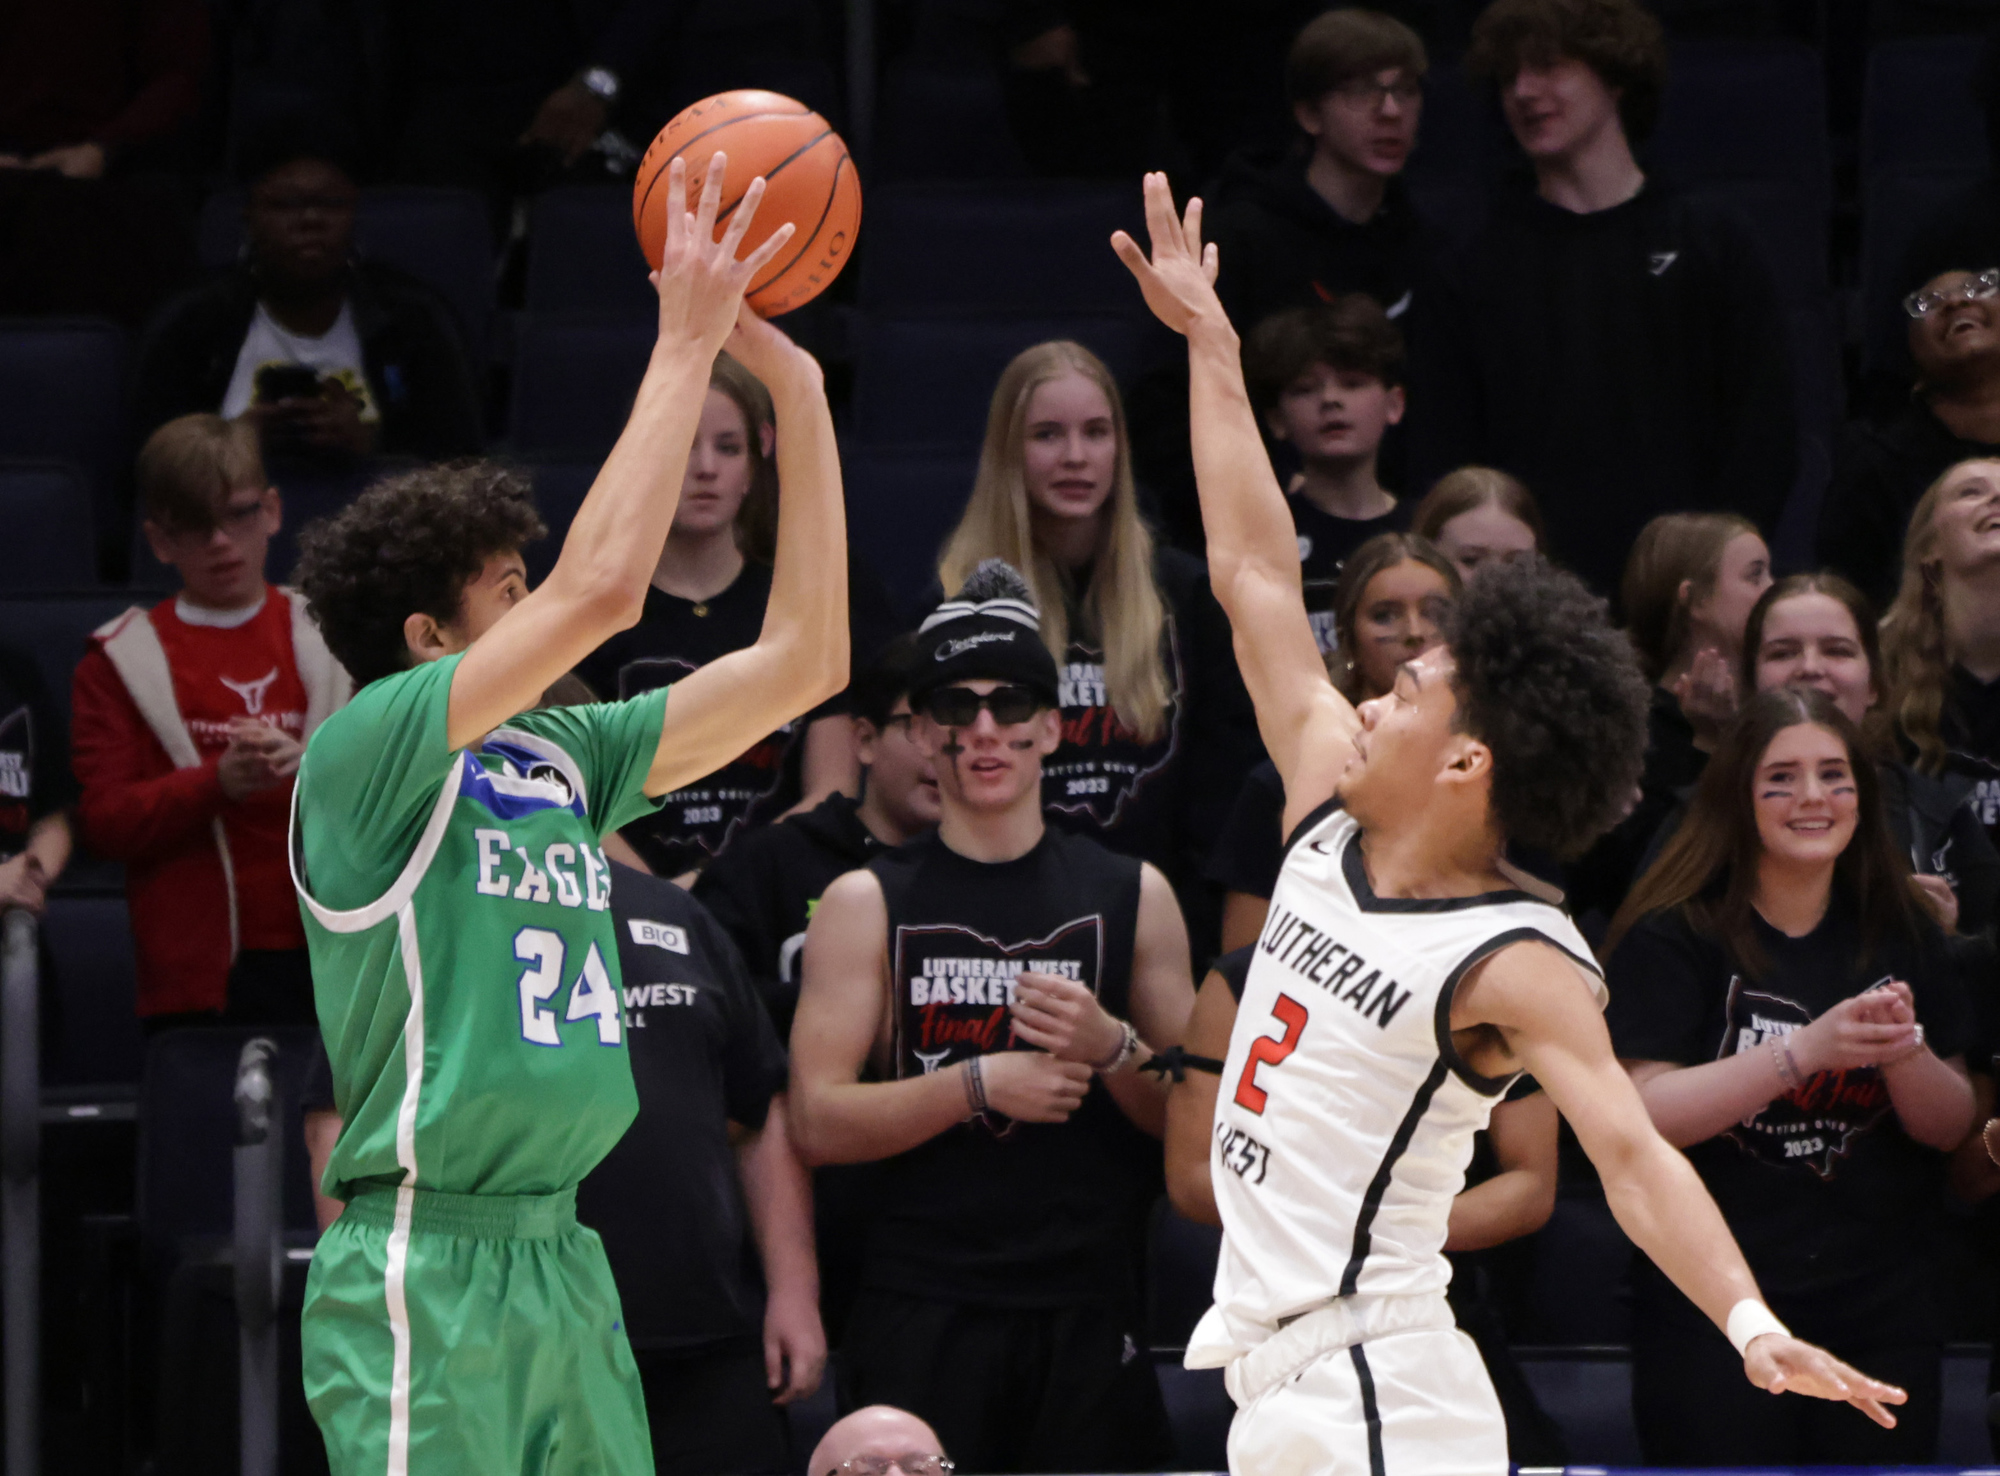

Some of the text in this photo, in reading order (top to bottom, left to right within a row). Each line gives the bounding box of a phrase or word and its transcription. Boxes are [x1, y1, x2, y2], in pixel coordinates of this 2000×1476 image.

[1066, 777, 1109, 795] 2023
[683, 804, 722, 825] 2023
[474, 828, 612, 912] EAGL
[641, 925, 678, 947] BIO
[922, 957, 1082, 980] LUTHERAN WEST
[1261, 903, 1413, 1031] LUTHERAN
[512, 924, 622, 1047] 24
[622, 983, 698, 1008] WEST
[910, 976, 1019, 1006] BASKET
[919, 998, 1006, 1050] Final
[1234, 991, 1309, 1117] 2
[1783, 1136, 1825, 1158] 2023
